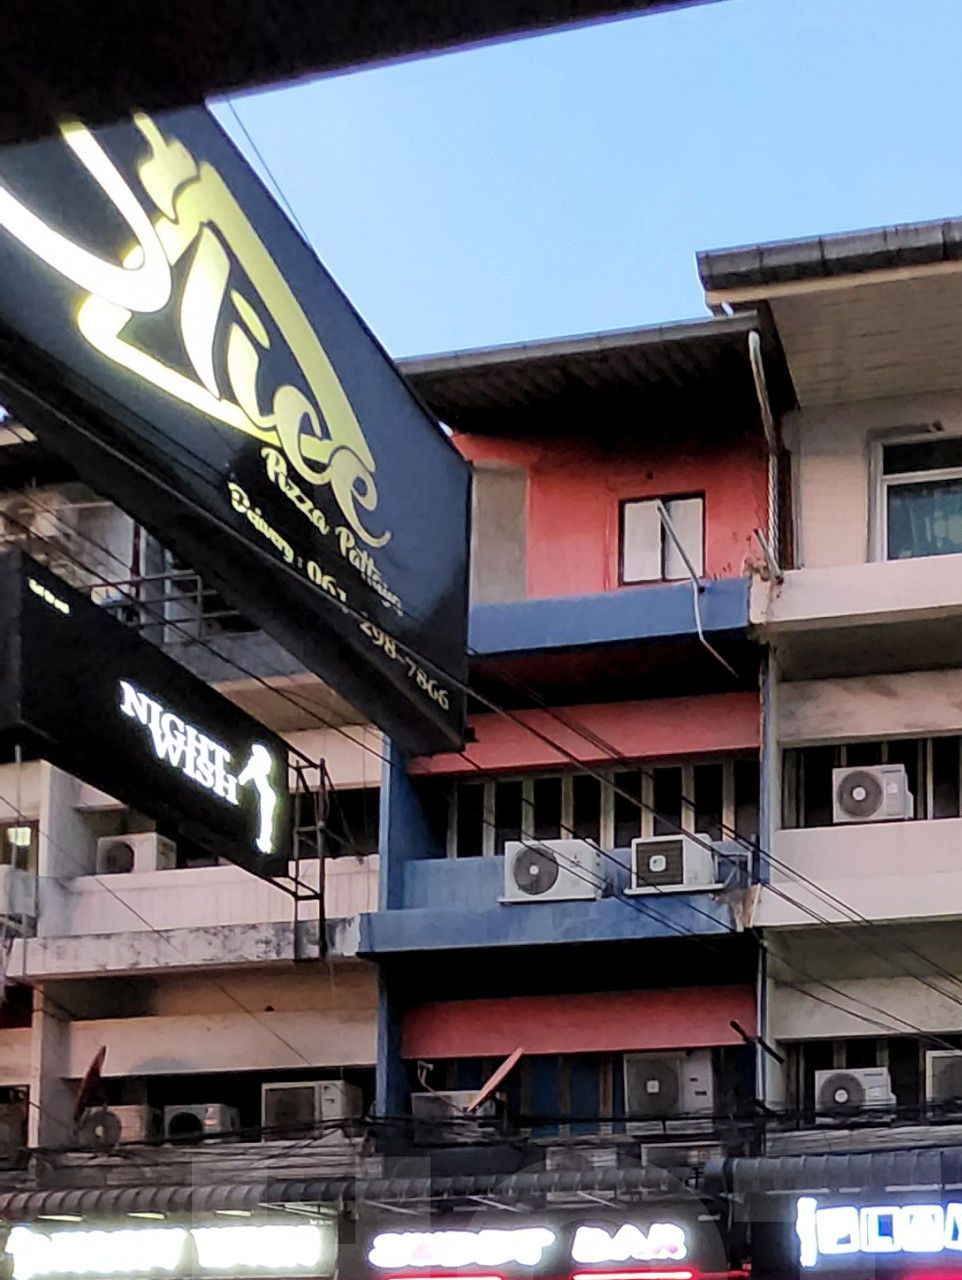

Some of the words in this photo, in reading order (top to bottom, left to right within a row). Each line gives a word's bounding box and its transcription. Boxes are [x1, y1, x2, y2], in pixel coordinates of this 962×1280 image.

[261, 447, 330, 535] Pizza
[119, 680, 231, 764] NIGHT
[148, 722, 240, 806] WISH
